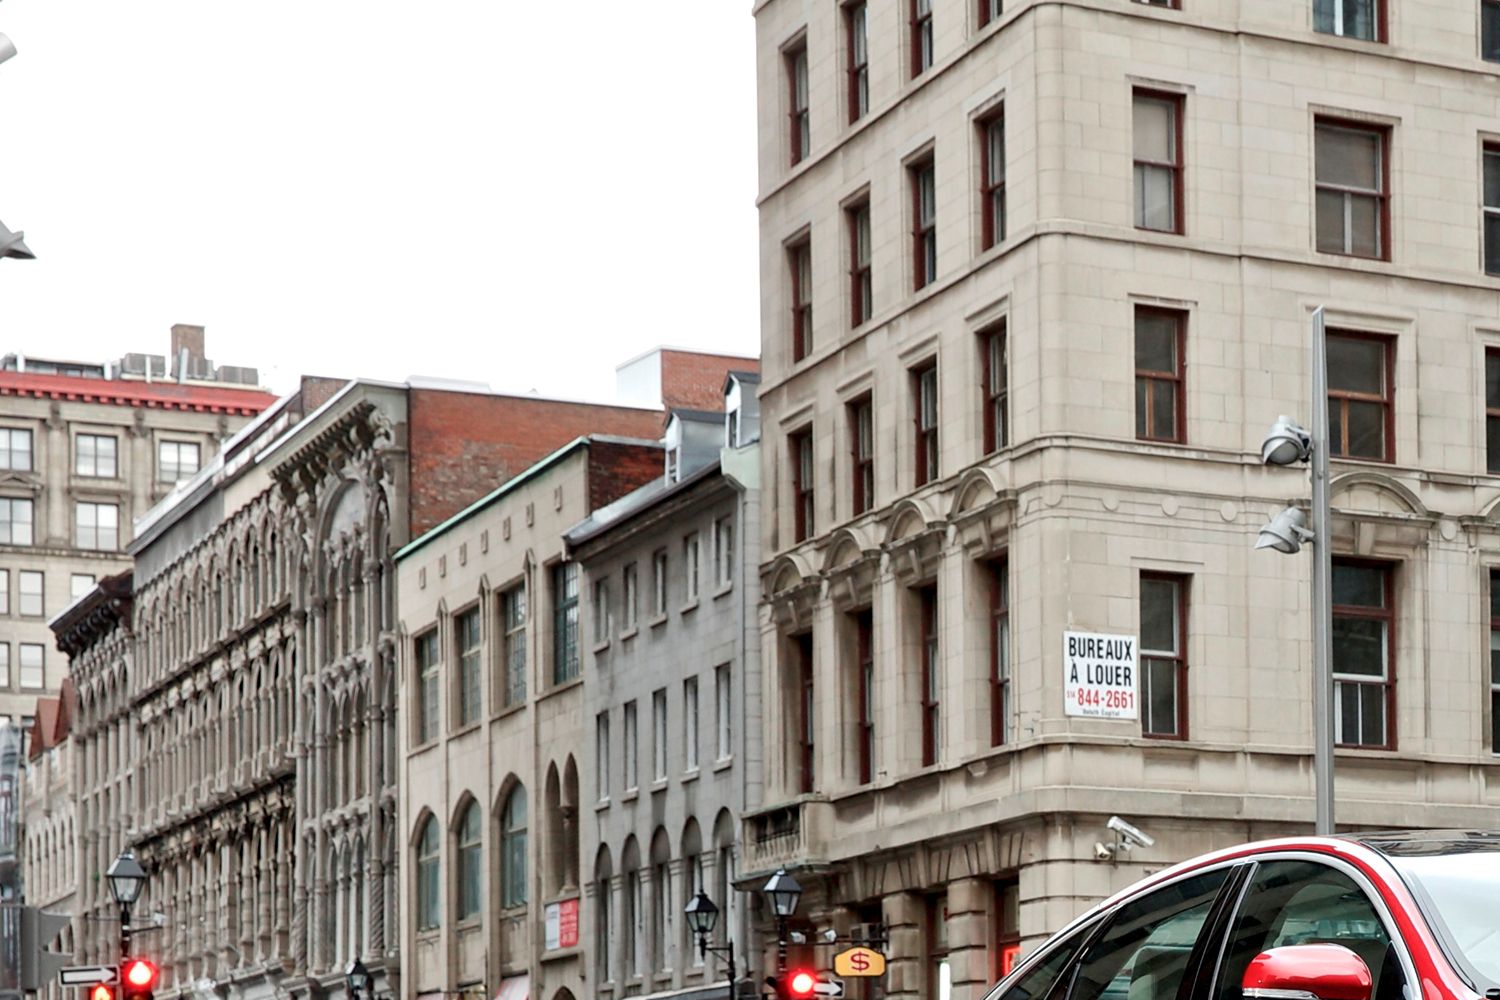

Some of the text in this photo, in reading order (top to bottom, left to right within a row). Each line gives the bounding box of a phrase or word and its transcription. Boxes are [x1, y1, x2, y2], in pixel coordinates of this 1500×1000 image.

[1069, 637, 1132, 661] BUREAUX
[1070, 659, 1132, 687] À LOUER
[1077, 688, 1133, 709] 844-2661
[850, 951, 870, 972] $
